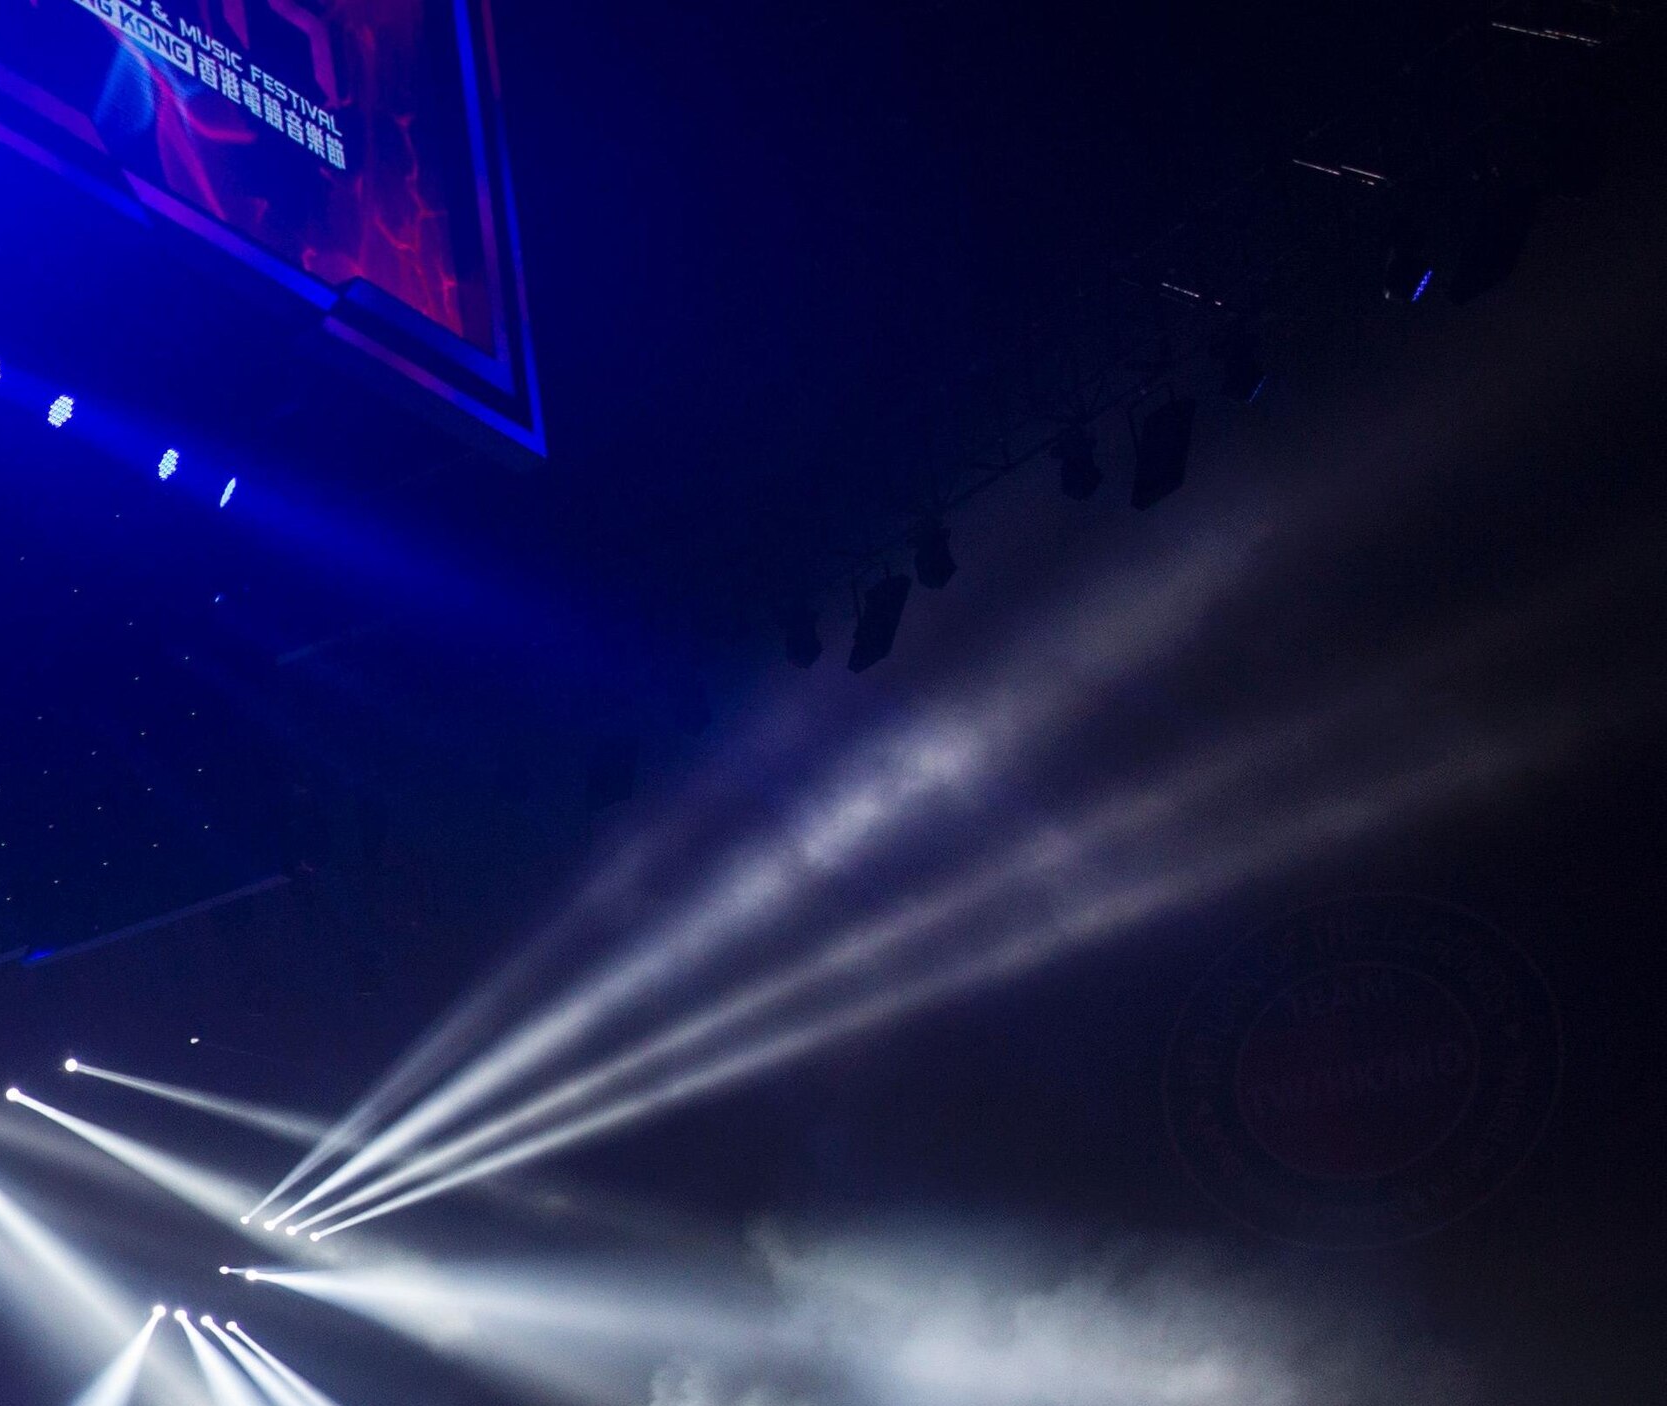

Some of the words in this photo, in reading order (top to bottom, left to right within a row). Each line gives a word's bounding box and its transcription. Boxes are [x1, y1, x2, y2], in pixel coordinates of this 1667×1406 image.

[118, 4, 190, 66] KONG
[151, 2, 172, 27] &
[179, 17, 243, 73] MUSIC
[250, 64, 343, 138] FESTIVAL
